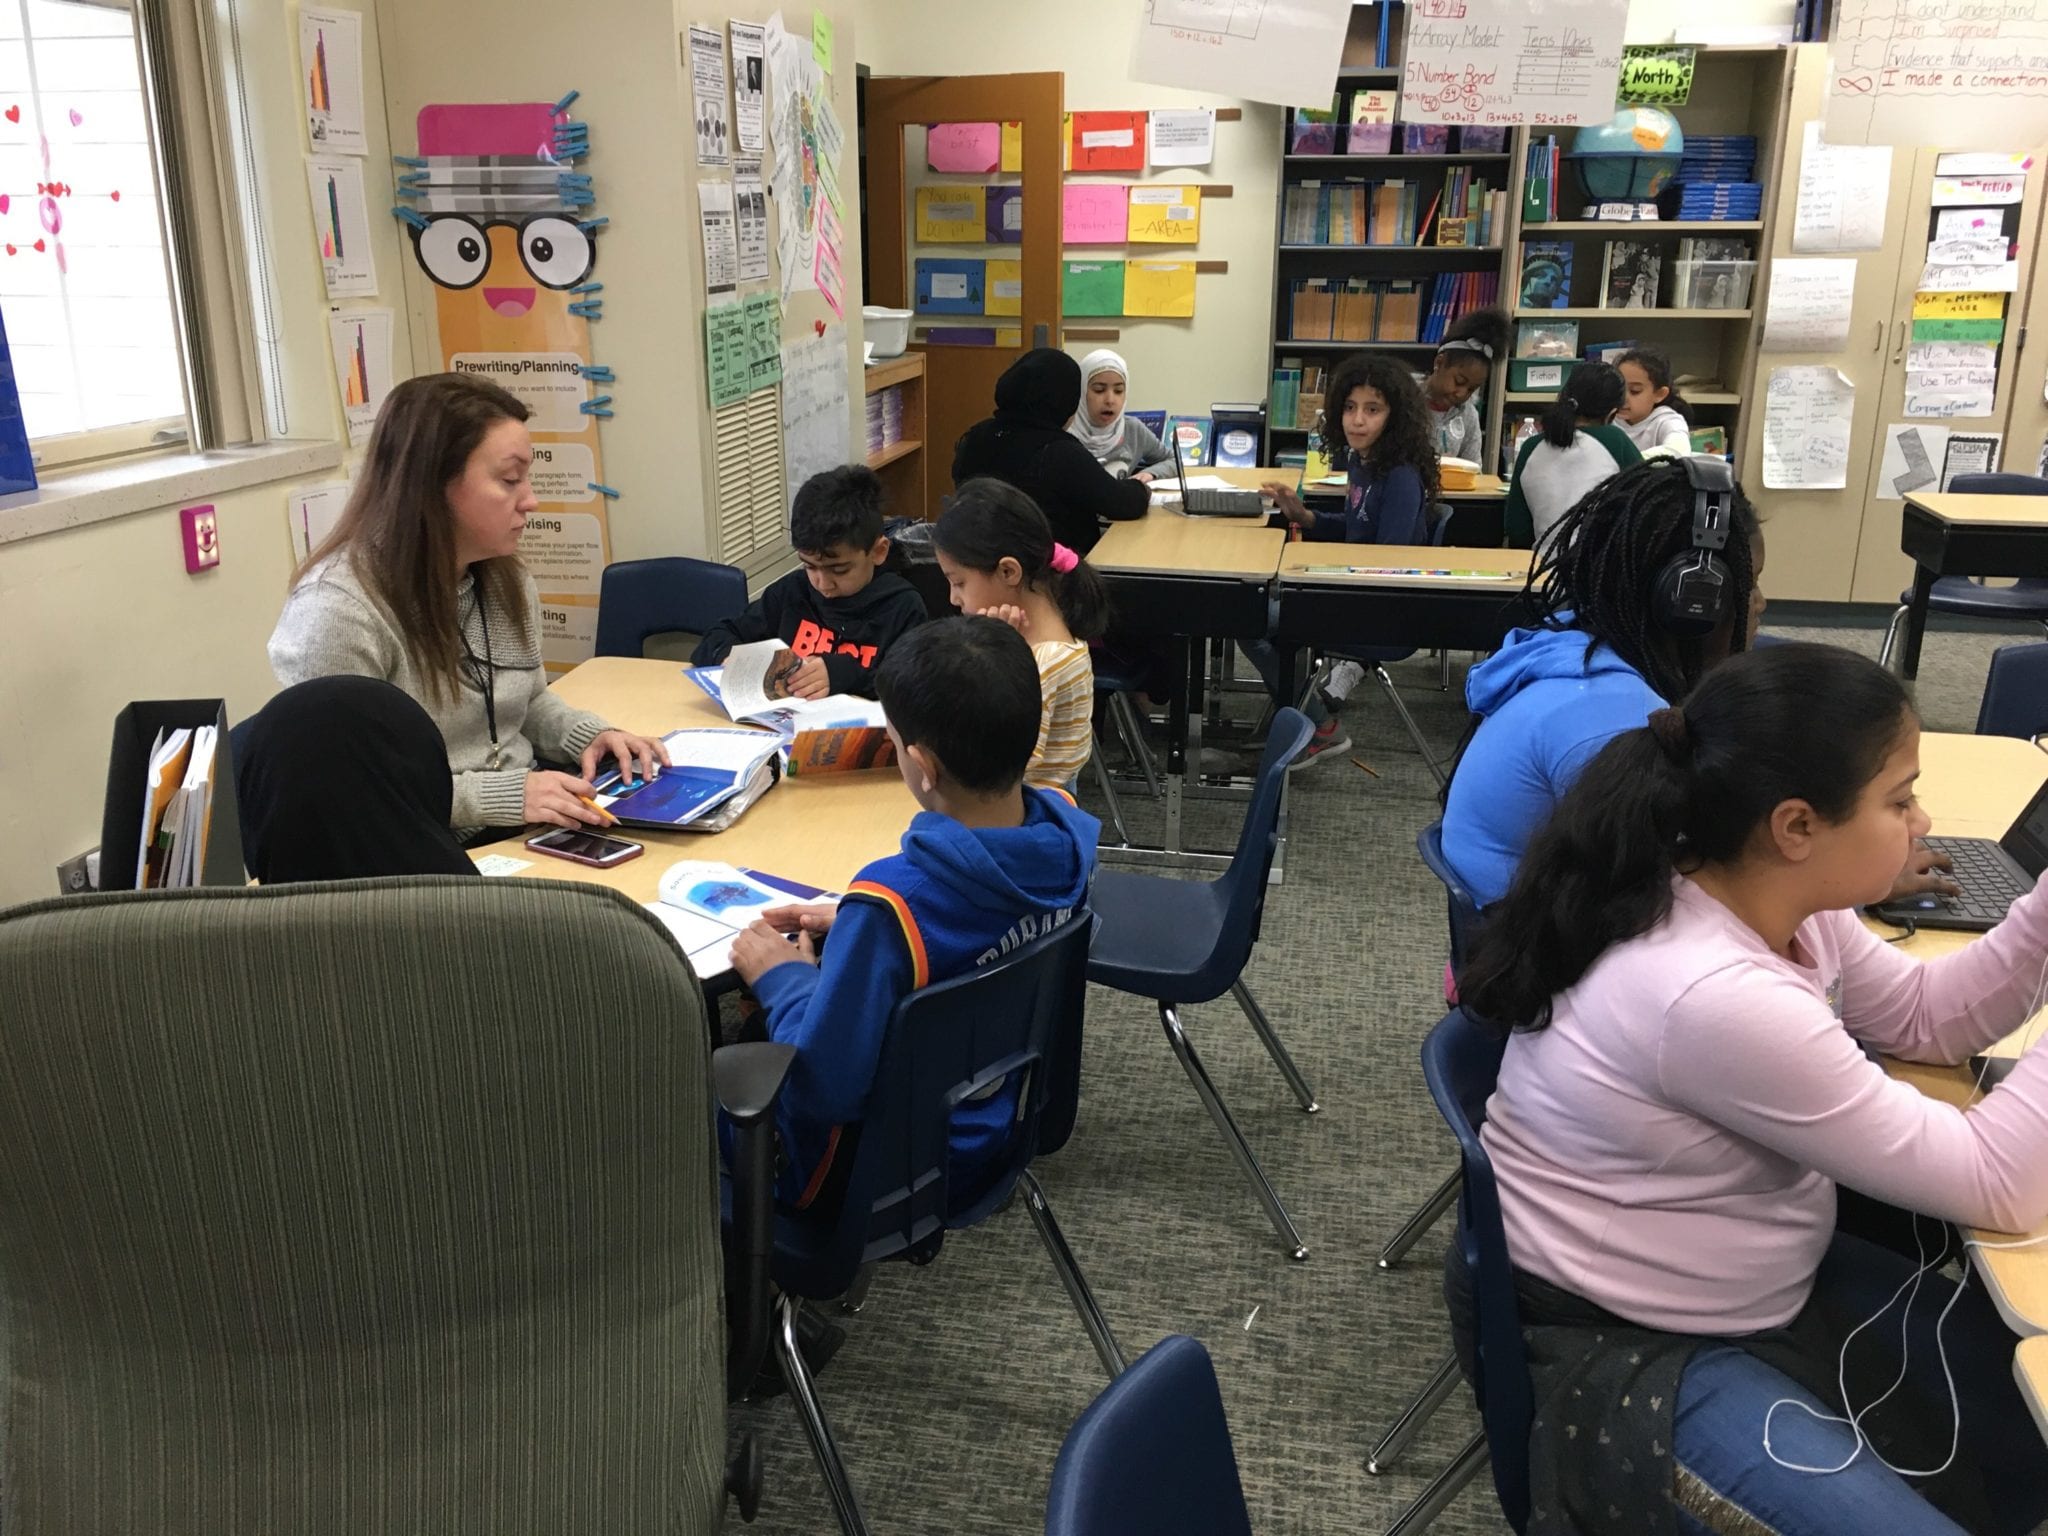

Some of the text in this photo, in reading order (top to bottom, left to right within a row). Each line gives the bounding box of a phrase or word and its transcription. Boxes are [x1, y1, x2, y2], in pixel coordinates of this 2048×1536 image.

[1523, 26, 1555, 47] Tens
[1950, 46, 1974, 66] that
[1418, 61, 1459, 83] Number
[1463, 63, 1498, 85] Bond
[1633, 67, 1674, 86] North
[1881, 69, 2048, 88] I made a connection
[1601, 205, 1631, 216] Globe
[455, 360, 579, 375] Prewriting/Planning
[1530, 370, 1557, 380] Fiction
[1921, 375, 1938, 387] Use
[1942, 374, 1964, 386] Text
[525, 518, 561, 532] vising
[542, 609, 567, 624] ting
